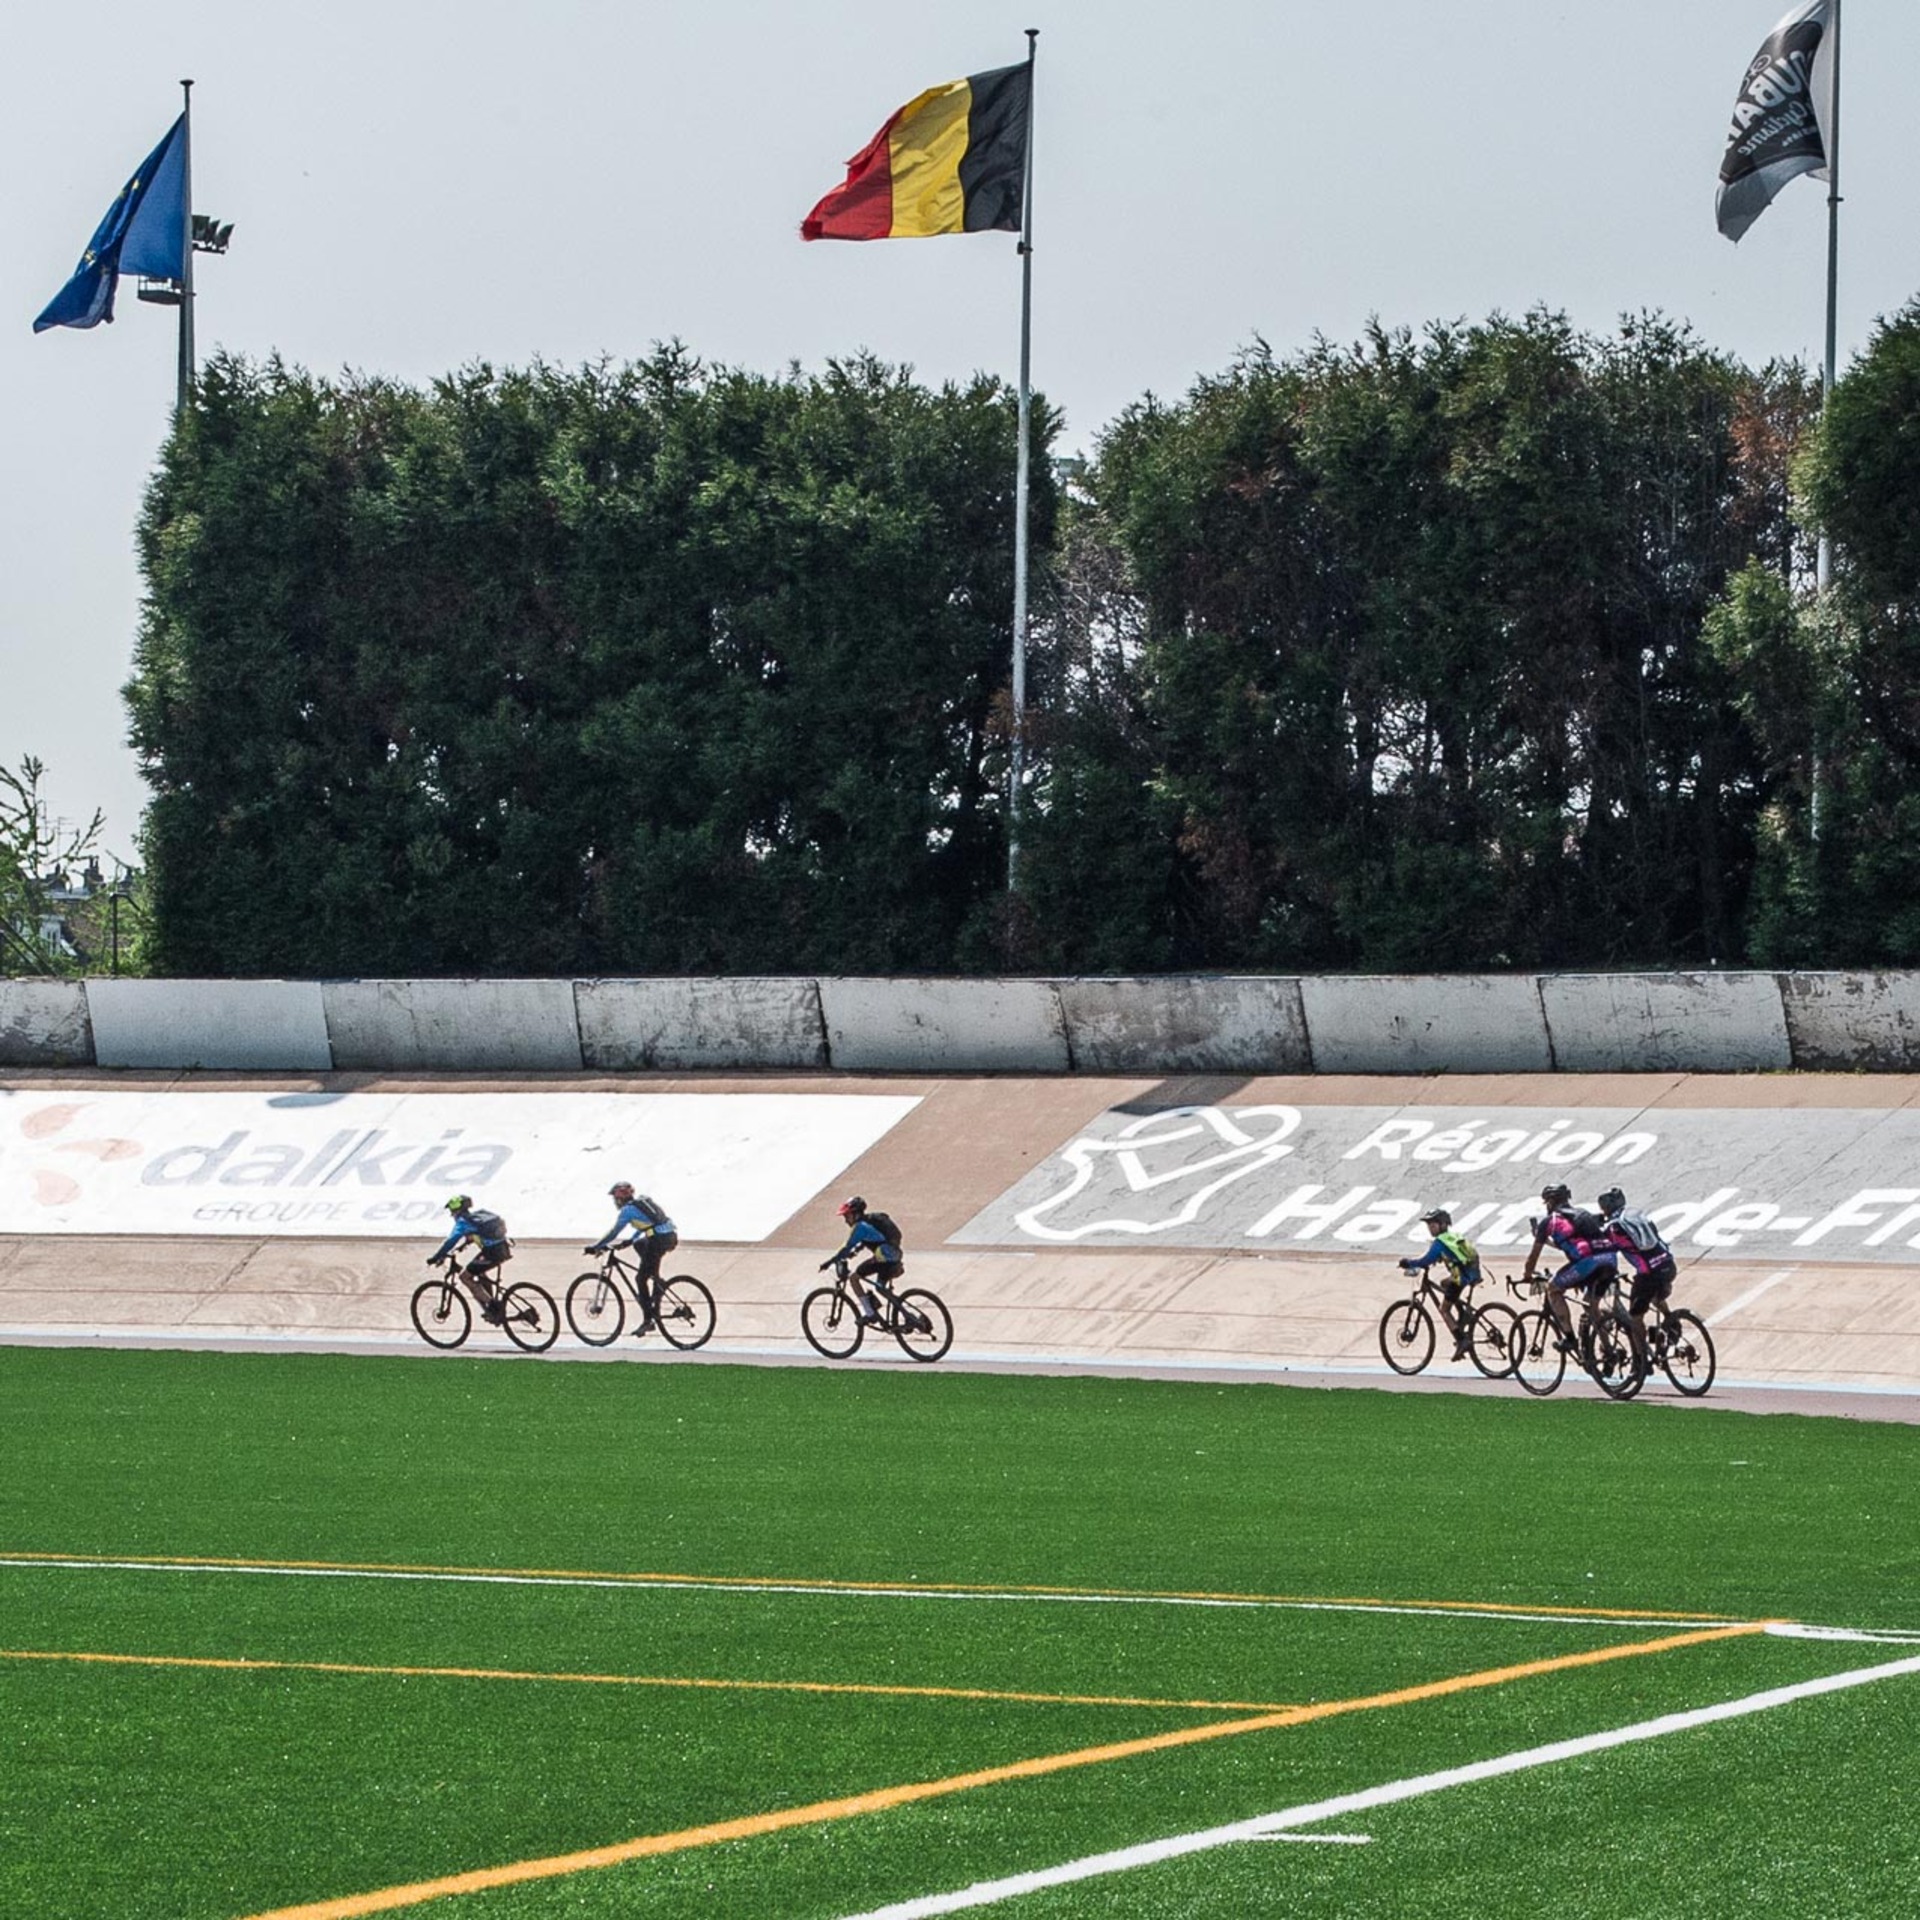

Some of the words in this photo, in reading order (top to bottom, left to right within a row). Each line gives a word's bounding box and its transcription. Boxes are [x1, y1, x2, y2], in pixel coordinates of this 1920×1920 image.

[141, 1129, 514, 1187] dalkia
[1343, 1120, 1658, 1173] Région
[191, 1200, 353, 1223] GROUPE
